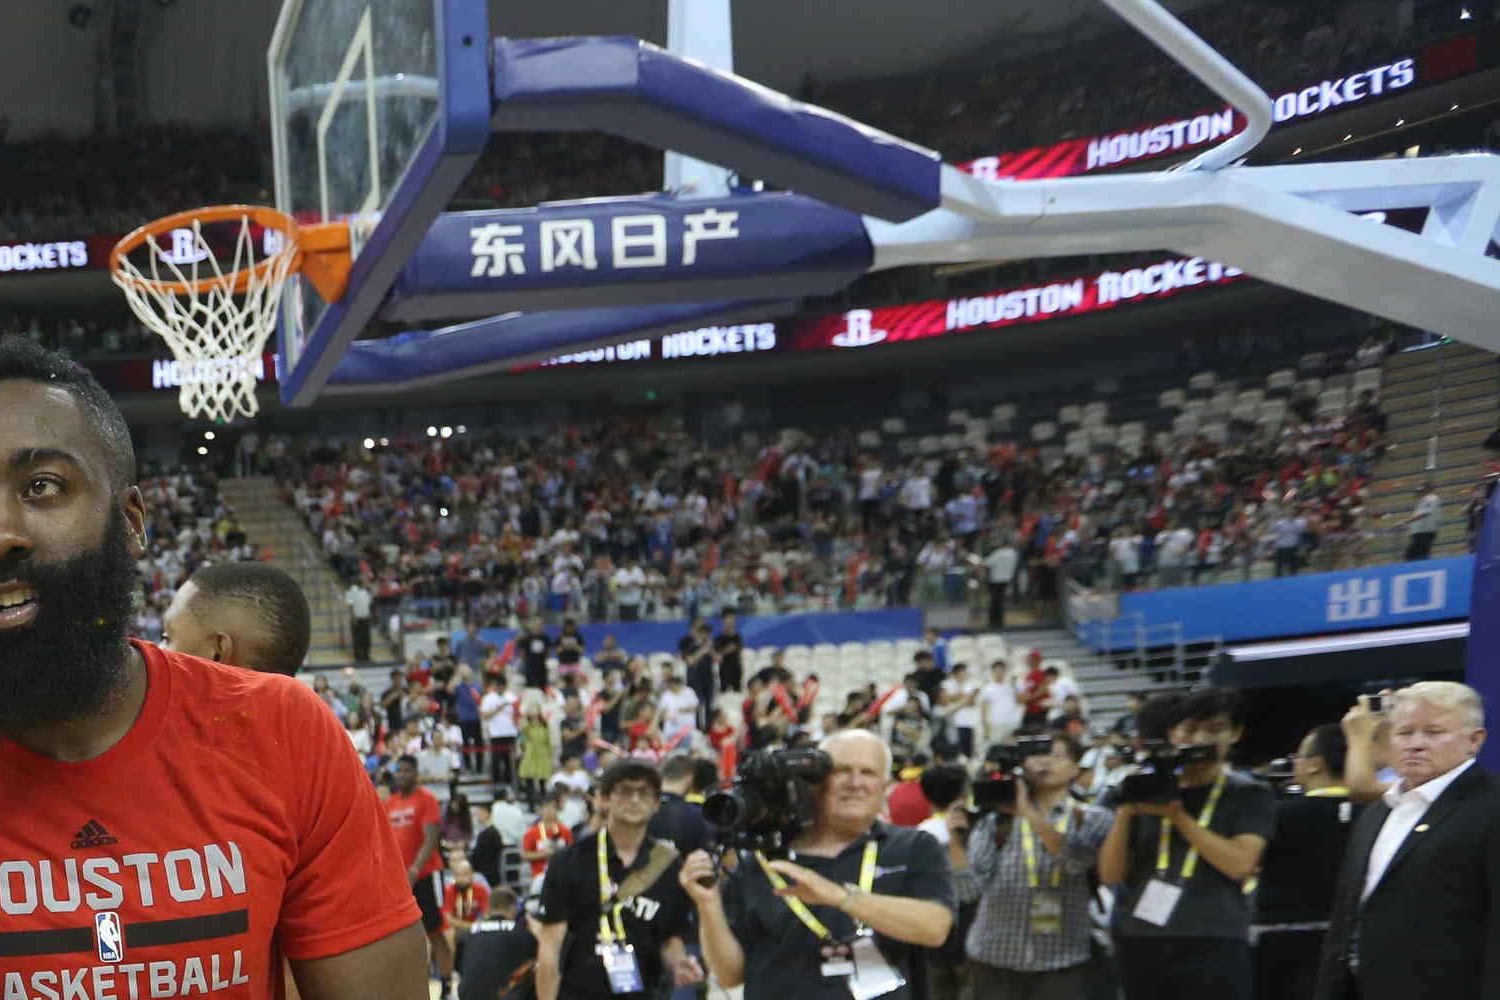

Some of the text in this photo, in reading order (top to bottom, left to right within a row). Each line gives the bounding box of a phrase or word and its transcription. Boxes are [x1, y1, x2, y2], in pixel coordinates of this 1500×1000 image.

[1086, 57, 1416, 169] HOUSTON OCKETS
[469, 208, 740, 278] 东风日产
[946, 279, 1083, 331] HOUSTON
[1327, 569, 1447, 623] 出口
